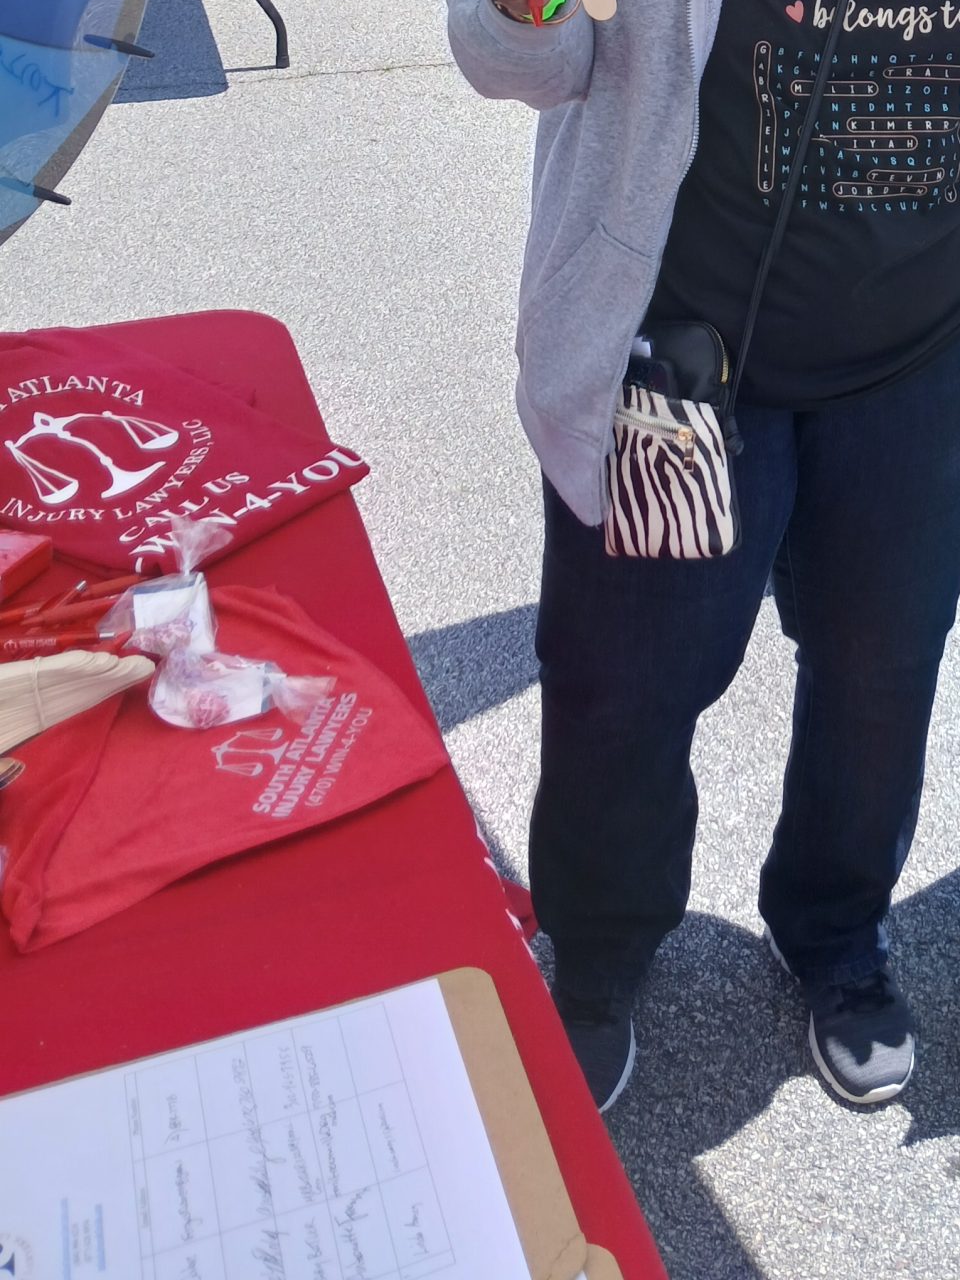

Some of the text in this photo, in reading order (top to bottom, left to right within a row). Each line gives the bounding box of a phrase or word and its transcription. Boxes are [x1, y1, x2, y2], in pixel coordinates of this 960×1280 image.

[7, 375, 145, 408] ATLANTA
[0, 497, 105, 523] INJURY
[119, 471, 251, 543] CALL US
[252, 697, 337, 814] SOUTH ATLANTA
[271, 692, 358, 818] INJURY LAWYERS
[304, 777, 337, 808] (470)
